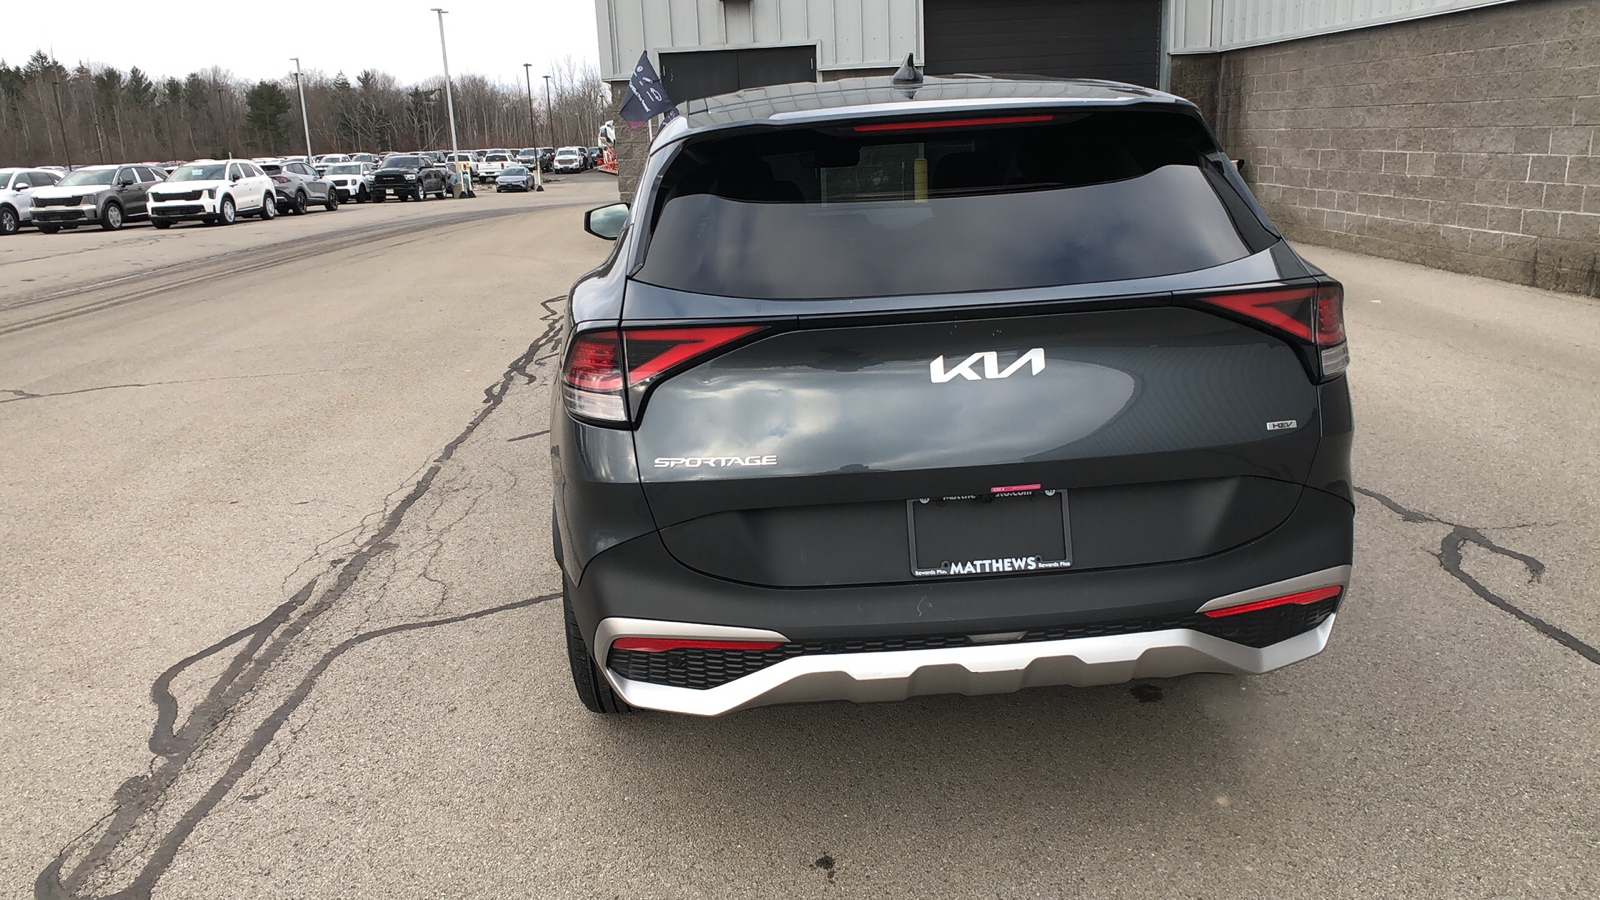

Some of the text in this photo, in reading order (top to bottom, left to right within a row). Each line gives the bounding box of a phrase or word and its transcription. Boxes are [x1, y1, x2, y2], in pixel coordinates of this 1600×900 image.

[929, 347, 1046, 383] KIA
[653, 455, 778, 468] SPORTAGE
[949, 557, 1036, 575] MATTHEWS
